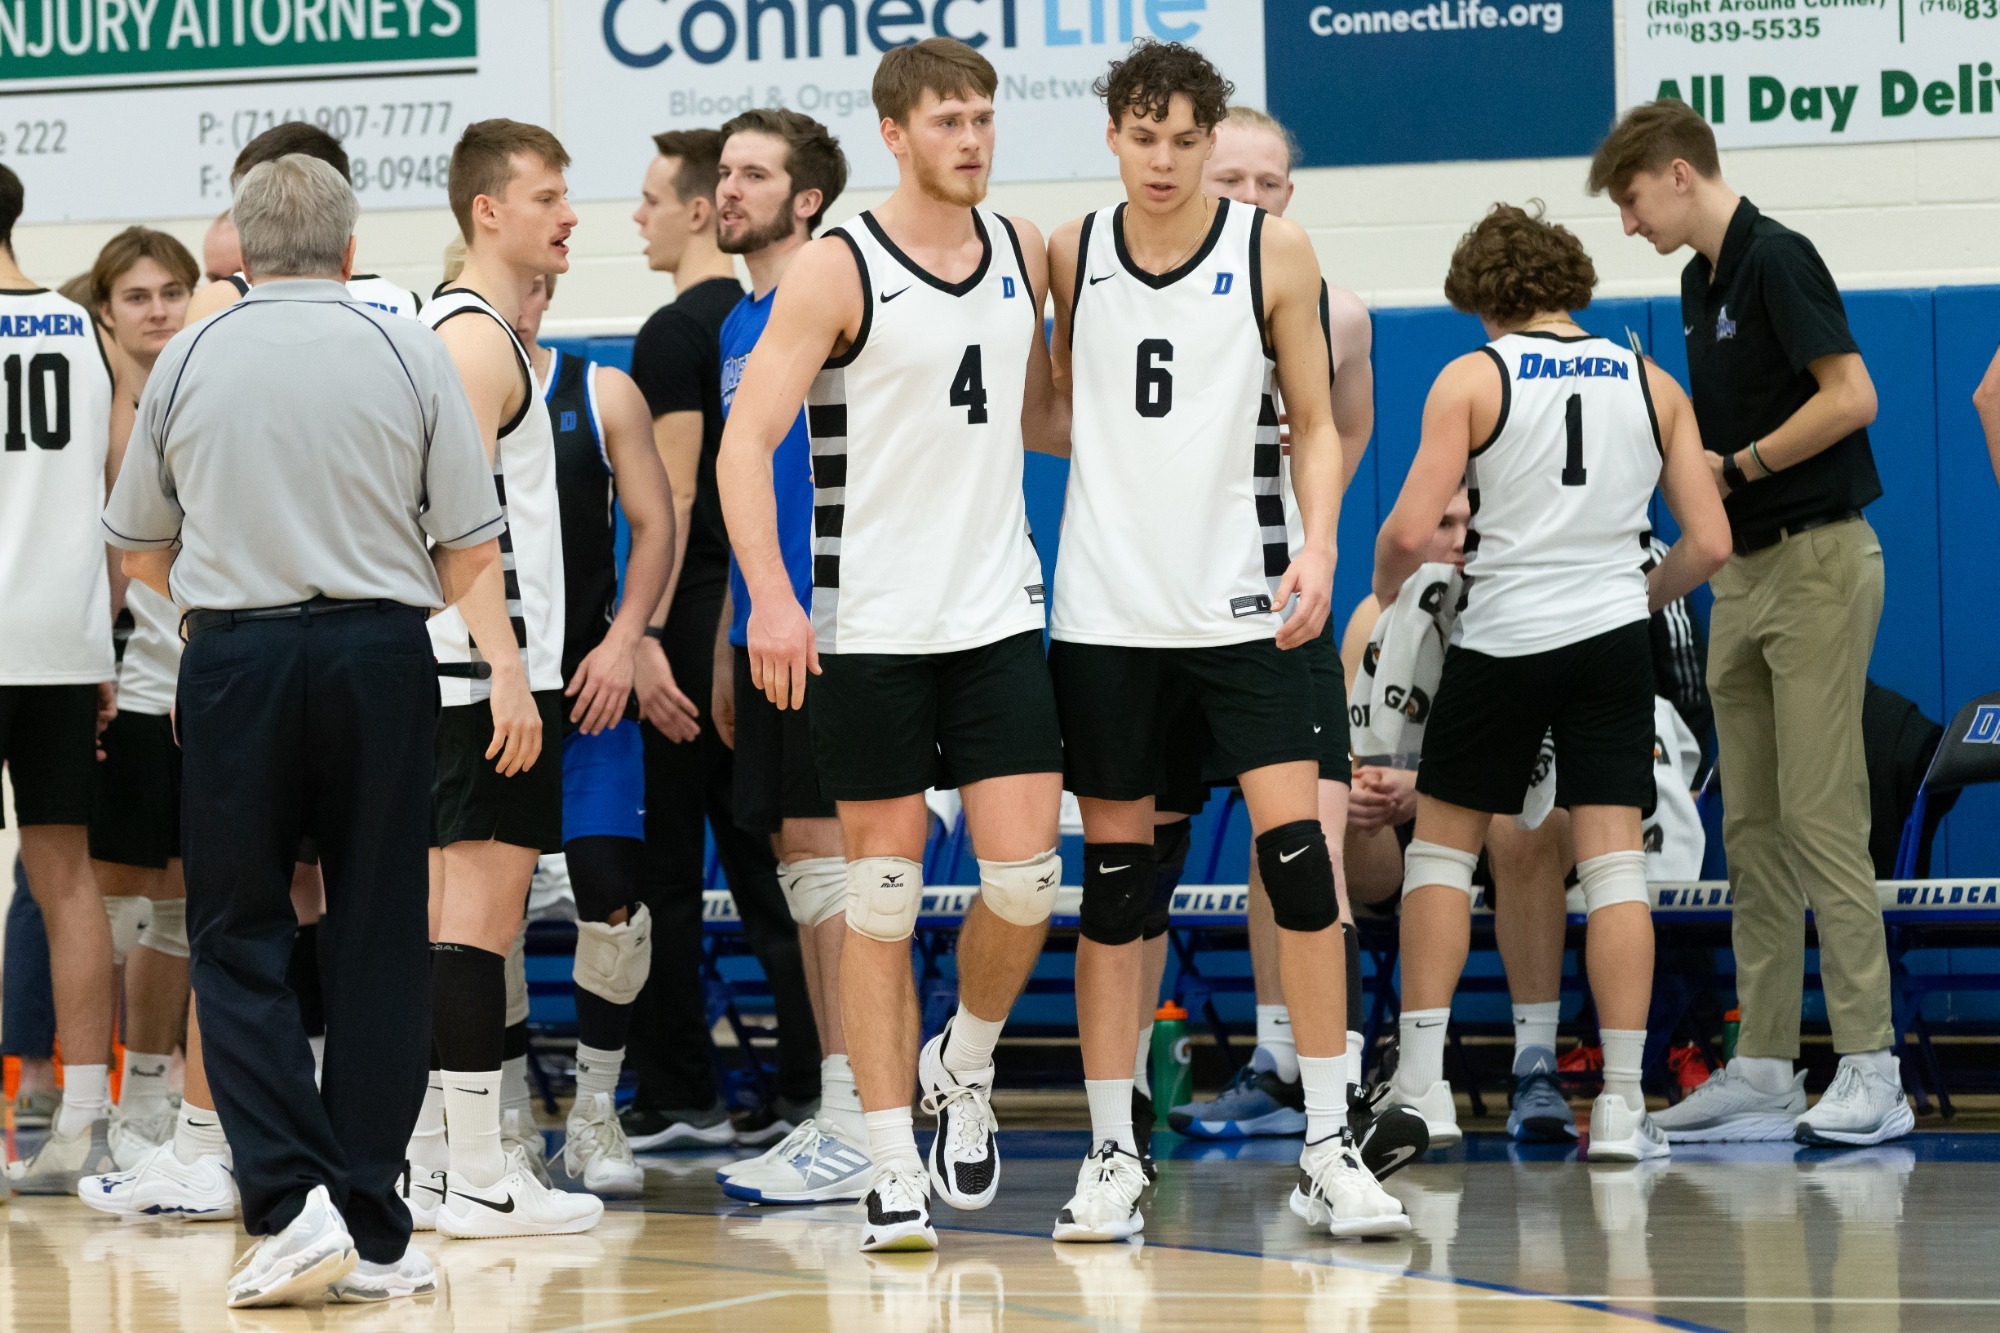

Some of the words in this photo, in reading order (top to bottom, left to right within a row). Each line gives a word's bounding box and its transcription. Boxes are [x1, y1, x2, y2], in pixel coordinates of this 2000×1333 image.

[166, 0, 462, 49] ATTORNEYS
[1309, 0, 1563, 36] ConnectLife.org
[1647, 0, 1710, 19] (Right
[1647, 17, 1821, 43] (716)839-5535
[669, 86, 753, 117] Blood
[1749, 75, 1860, 133] Day
[1881, 61, 2000, 118] Deli
[15, 119, 68, 155] 222
[199, 112, 224, 145] P:
[315, 101, 453, 140] 907-7777
[200, 165, 223, 199] F:
[1002, 276, 1016, 299] D
[1211, 272, 1234, 295] D
[949, 343, 988, 425] 4
[1135, 338, 1174, 418] 6
[4, 352, 71, 452] 10
[560, 411, 577, 432] D
[1561, 392, 1587, 487] 1
[1962, 704, 2000, 744] D
[1897, 886, 1997, 904] WILDCA
